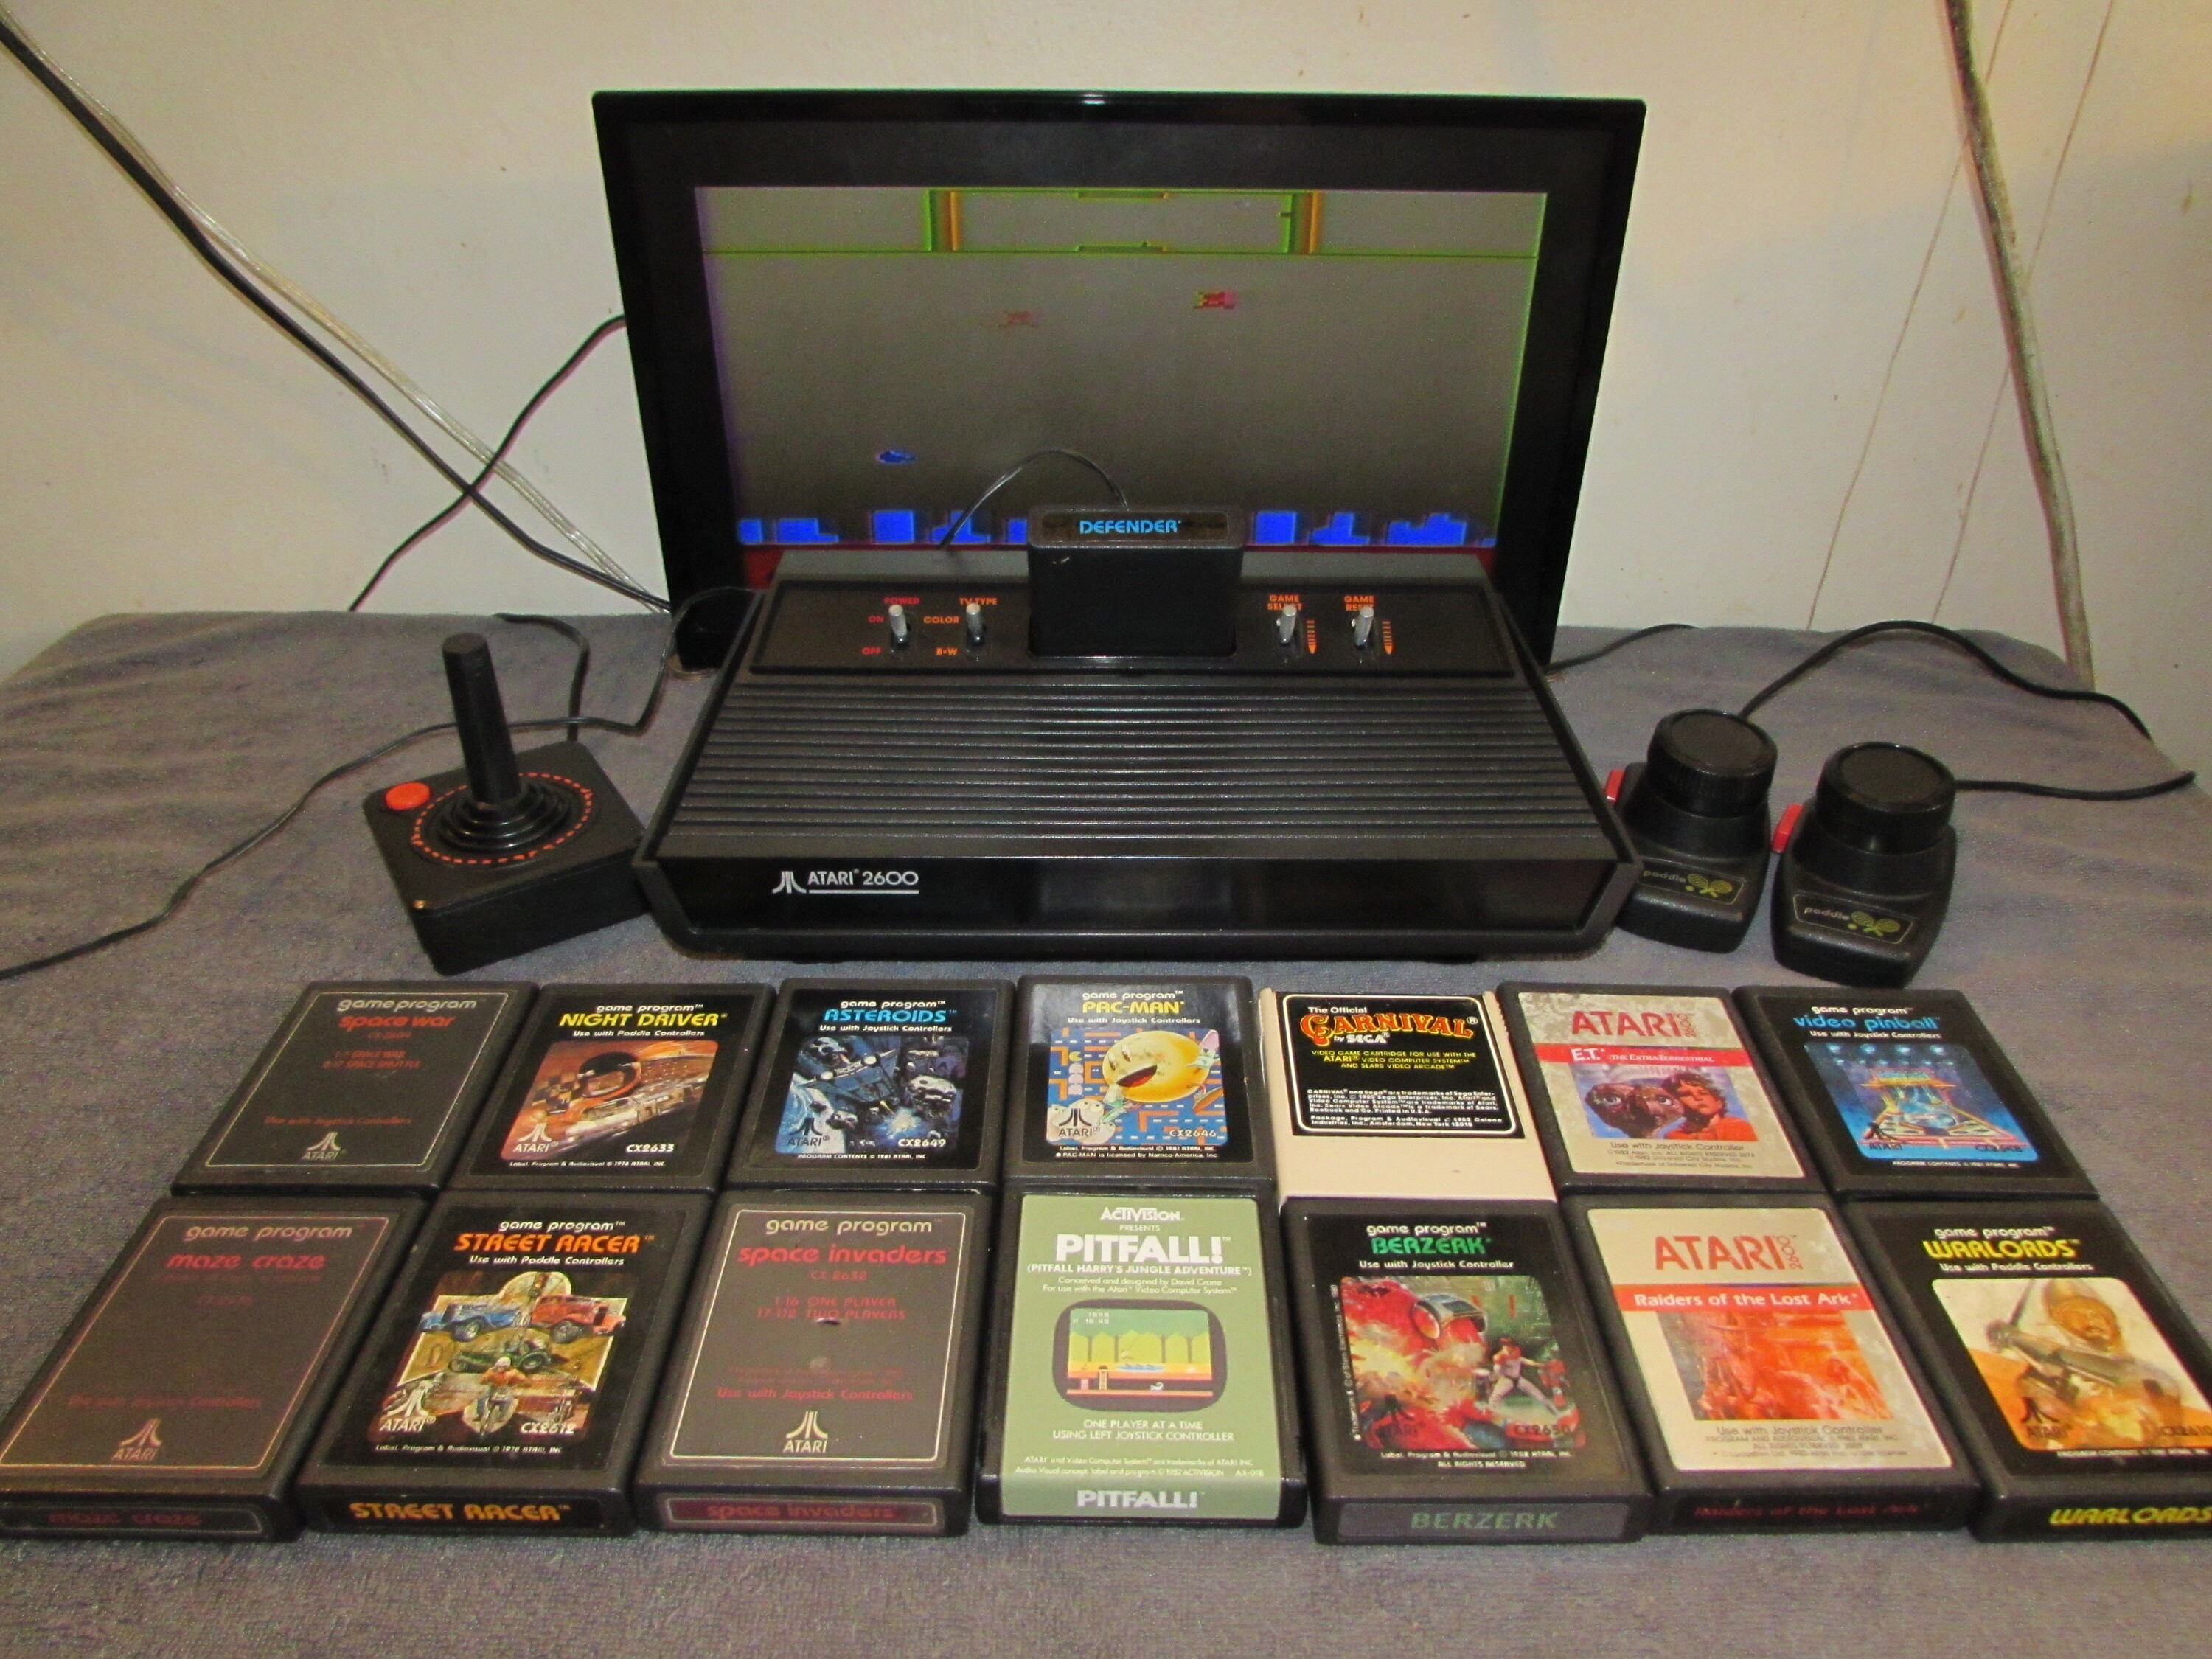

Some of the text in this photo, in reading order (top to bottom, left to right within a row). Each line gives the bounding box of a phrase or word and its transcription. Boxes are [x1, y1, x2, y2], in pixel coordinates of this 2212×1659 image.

[1079, 520, 1178, 534] DEFENDER
[862, 871, 919, 885] 2600
[1643, 870, 1686, 883] paddle
[1804, 906, 1851, 921] paddle
[337, 999, 477, 1012] game program
[597, 1005, 633, 1013] game
[841, 1001, 877, 1009] game
[1082, 1001, 1180, 1013] PAC-MAN
[1811, 1006, 1847, 1015] game
[338, 1015, 456, 1032] space war
[559, 1013, 633, 1026] NIGHT
[1572, 1010, 1680, 1037] ATARI
[1793, 1015, 1939, 1032] video pinball
[1334, 1035, 1345, 1043] by
[1169, 1129, 1216, 1137] CX2646
[626, 1144, 675, 1153] CX2633
[898, 1139, 947, 1147] CX2649
[301, 1151, 338, 1161] ATARI
[1099, 1206, 1180, 1222] ACTIVISION
[498, 1220, 543, 1232] game
[765, 1219, 932, 1235] game program
[1366, 1224, 1409, 1236] game
[183, 1225, 352, 1242] game program
[1934, 1228, 1978, 1239] game
[453, 1233, 551, 1251] STREET
[1371, 1237, 1487, 1254] BERZERK
[737, 1244, 947, 1267] space invaders
[1055, 1234, 1223, 1264] PITFALL!
[1655, 1235, 1803, 1270] ATARI 2600
[165, 1254, 327, 1270] maze craze
[469, 1256, 625, 1265] Use with Paddle Controllers
[1359, 1260, 1514, 1270] Use with Joystick Controller
[1077, 1265, 1123, 1274] HARRY'S
[1125, 1265, 1172, 1275] JUNGLE
[1058, 1276, 1102, 1285] Conceived
[1103, 1277, 1119, 1285] and
[1120, 1277, 1158, 1286] designed
[1159, 1279, 1169, 1287] by
[1171, 1278, 1195, 1286] David
[1161, 1286, 1202, 1295] Computer
[807, 1296, 897, 1307] ONE PLAYER
[1634, 1293, 1702, 1306] Raiders
[1708, 1293, 1728, 1306] of
[1733, 1293, 1766, 1306] the
[1770, 1293, 1812, 1306] Lost
[805, 1309, 907, 1320] TWO PLAYERS
[717, 1388, 914, 1399] Use with Joystick Controllers
[1083, 1419, 1203, 1429] ONE PLAYER AT A TIME
[1717, 1425, 1882, 1435] Use with Joystick Controller
[1052, 1430, 1235, 1441] USING LEFT JOYSTICK CONTROLLER
[782, 1440, 827, 1453] ATARI
[112, 1447, 159, 1461] ATARI
[1077, 1489, 1198, 1509] PITFALL!
[349, 1502, 453, 1519] STREET
[2050, 1507, 2212, 1524] WARLORDS
[1410, 1512, 1559, 1530] BERZERK
